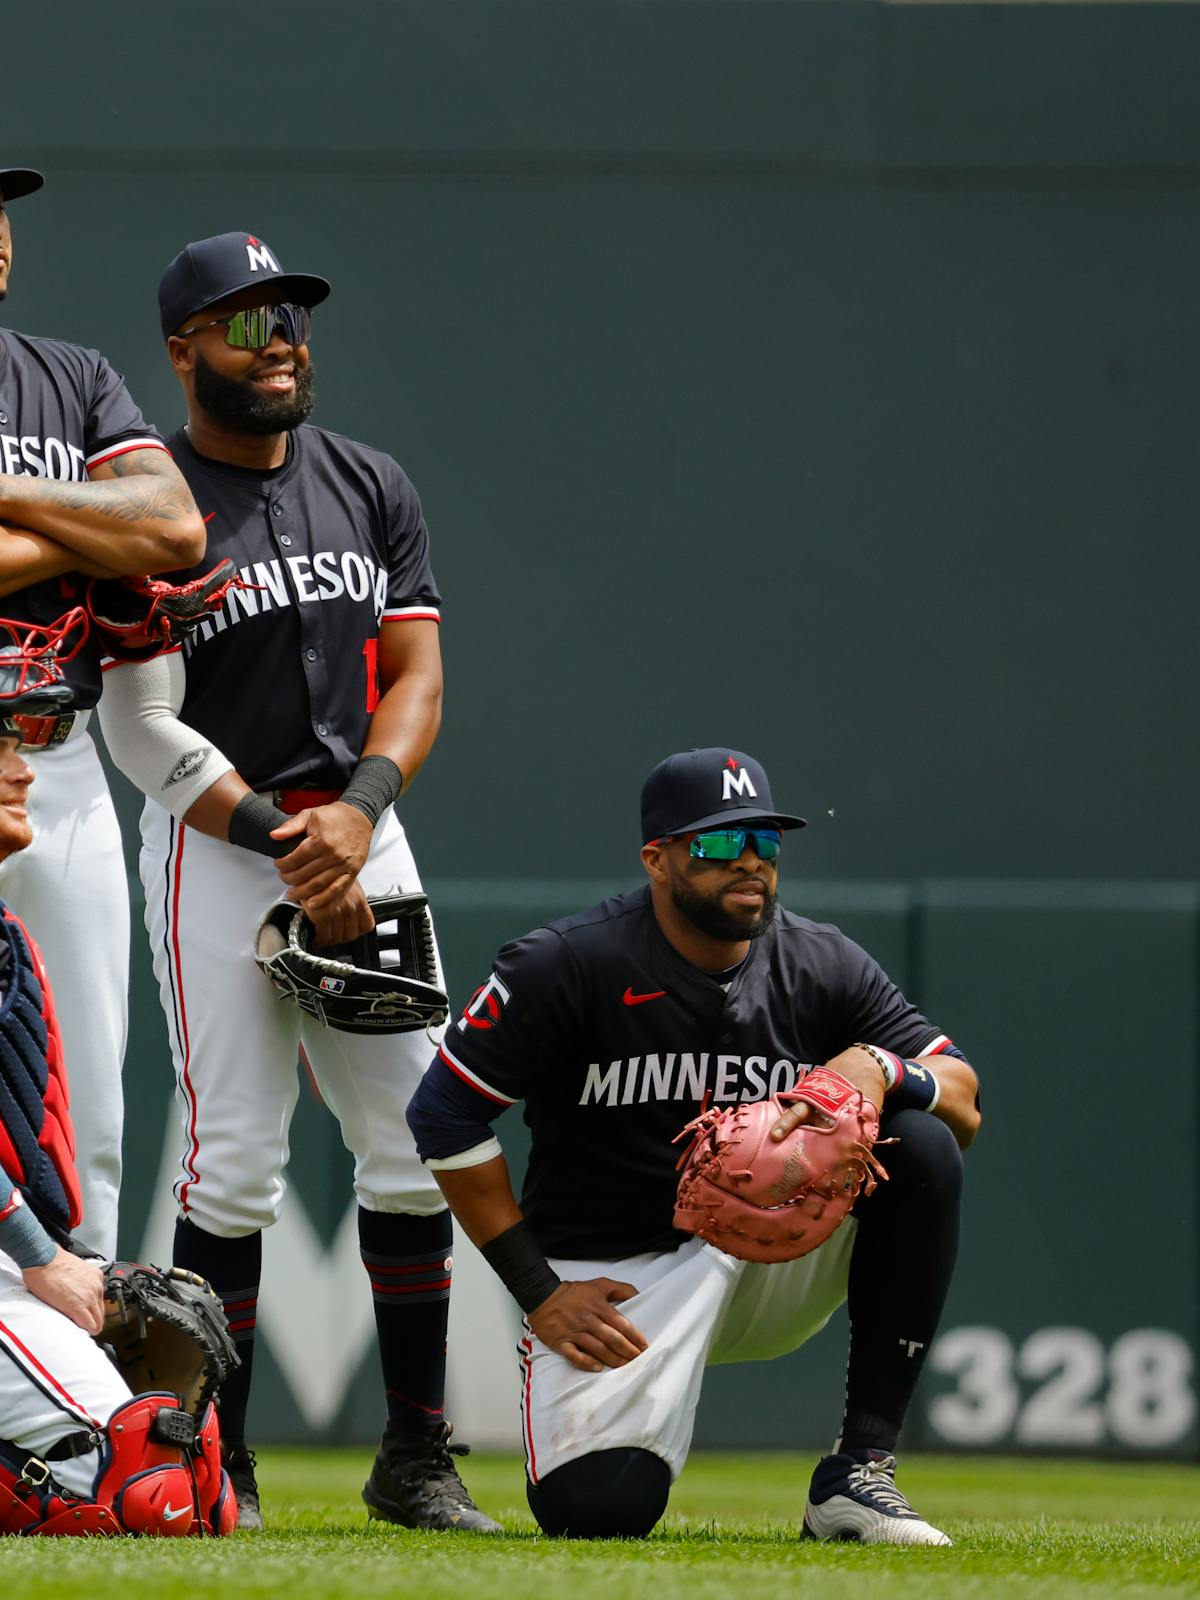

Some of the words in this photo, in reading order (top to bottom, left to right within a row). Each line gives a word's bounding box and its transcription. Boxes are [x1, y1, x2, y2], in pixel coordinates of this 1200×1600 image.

[246, 245, 280, 272] M
[184, 551, 389, 660] NNESOTA
[721, 767, 758, 800] M
[928, 1325, 1196, 1446] 328
